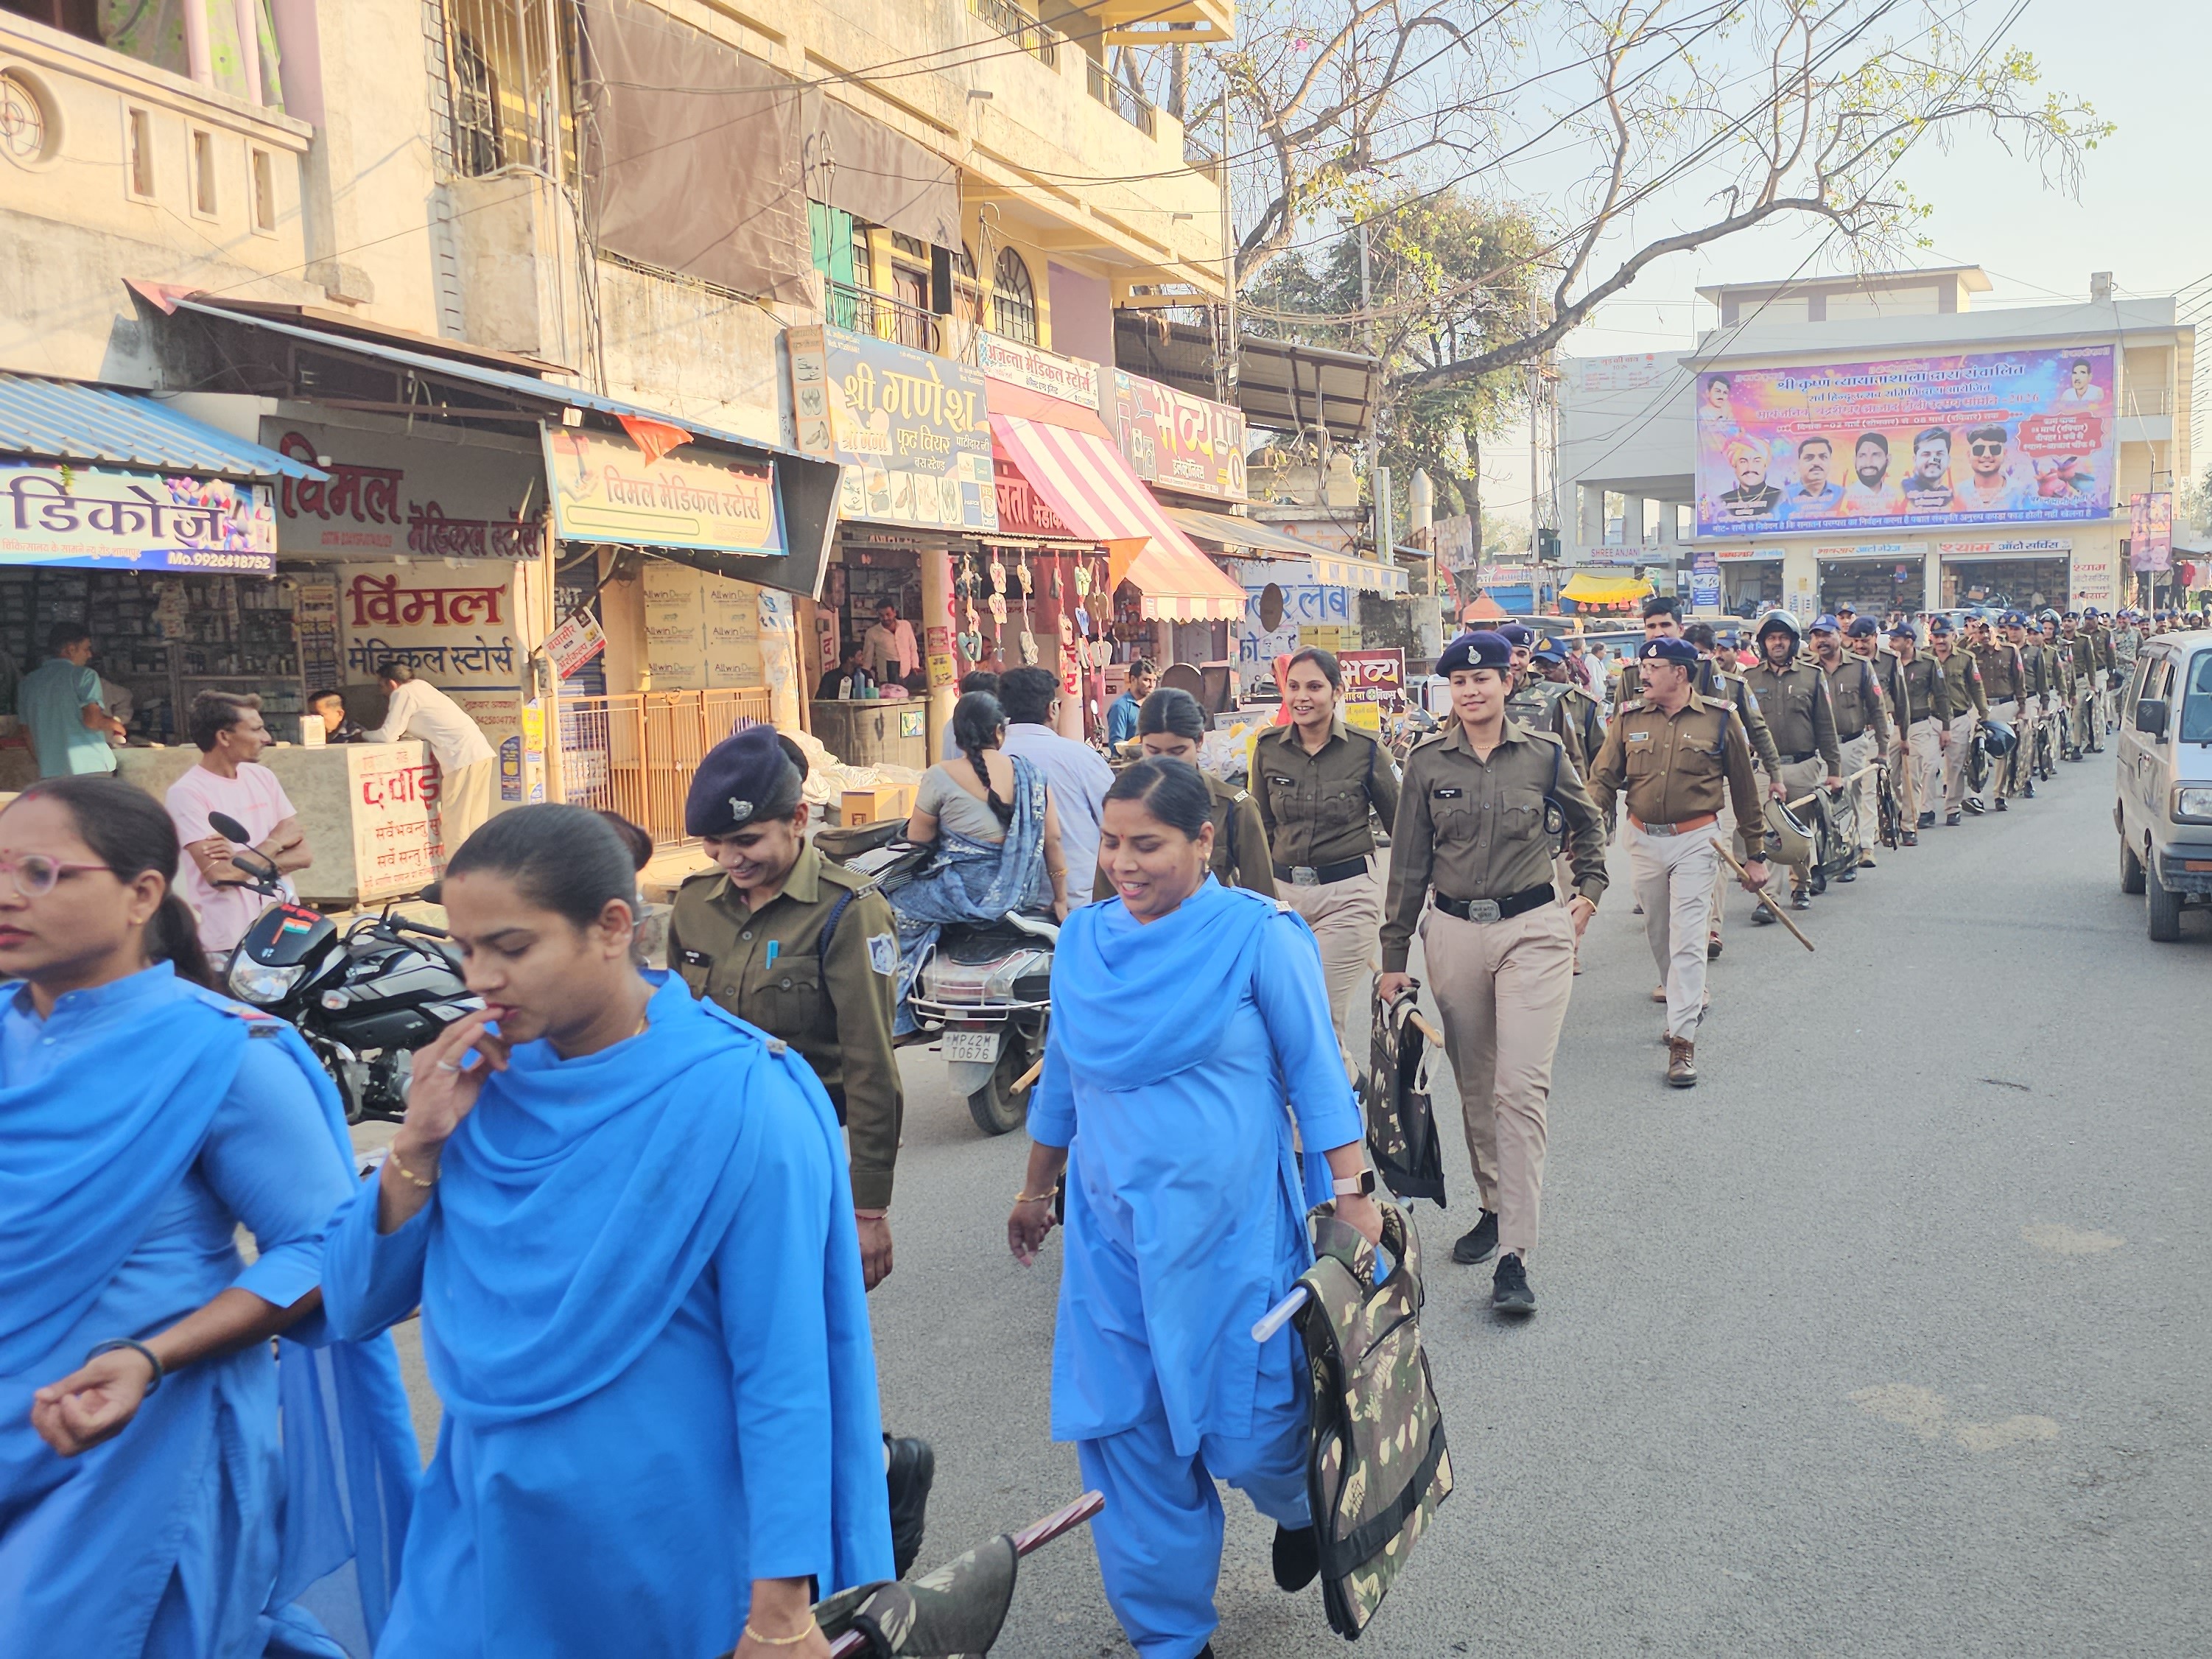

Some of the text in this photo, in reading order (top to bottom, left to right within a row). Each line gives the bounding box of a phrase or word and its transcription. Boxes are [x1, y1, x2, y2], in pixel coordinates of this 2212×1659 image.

[987, 343, 1024, 370] अजन्ता
[1025, 351, 1064, 383] मेडिकल
[1065, 368, 1090, 392] स्टोर्स
[844, 361, 977, 433] श्री गणेश
[1777, 377, 1794, 390] श्री
[1151, 384, 1215, 464] भव्य
[896, 427, 918, 456] फूट
[920, 424, 950, 455] वियर
[280, 431, 404, 525] विमल
[407, 499, 488, 557] मेडिकल
[604, 464, 762, 520] विमल मेडिकल स्टोर्स
[994, 465, 1029, 525] जंता
[0, 475, 227, 547] डिकोज
[52, 541, 59, 553] के
[61, 541, 84, 554] सामने
[1591, 548, 1640, 558] SHREE ANJANI
[1939, 542, 1994, 553] श्याम
[2074, 564, 2107, 572] श्याम
[345, 574, 507, 626] विमल
[711, 590, 737, 600] Allwin
[713, 627, 738, 636] Allwin
[348, 635, 514, 675] मेडिकल स्टोर्स
[714, 663, 741, 672] Allwin
[1340, 659, 1400, 690] भव्य
[377, 848, 396, 868] सर्वे
[398, 848, 421, 866] सन्तु
[952, 1047, 989, 1059] T0676
